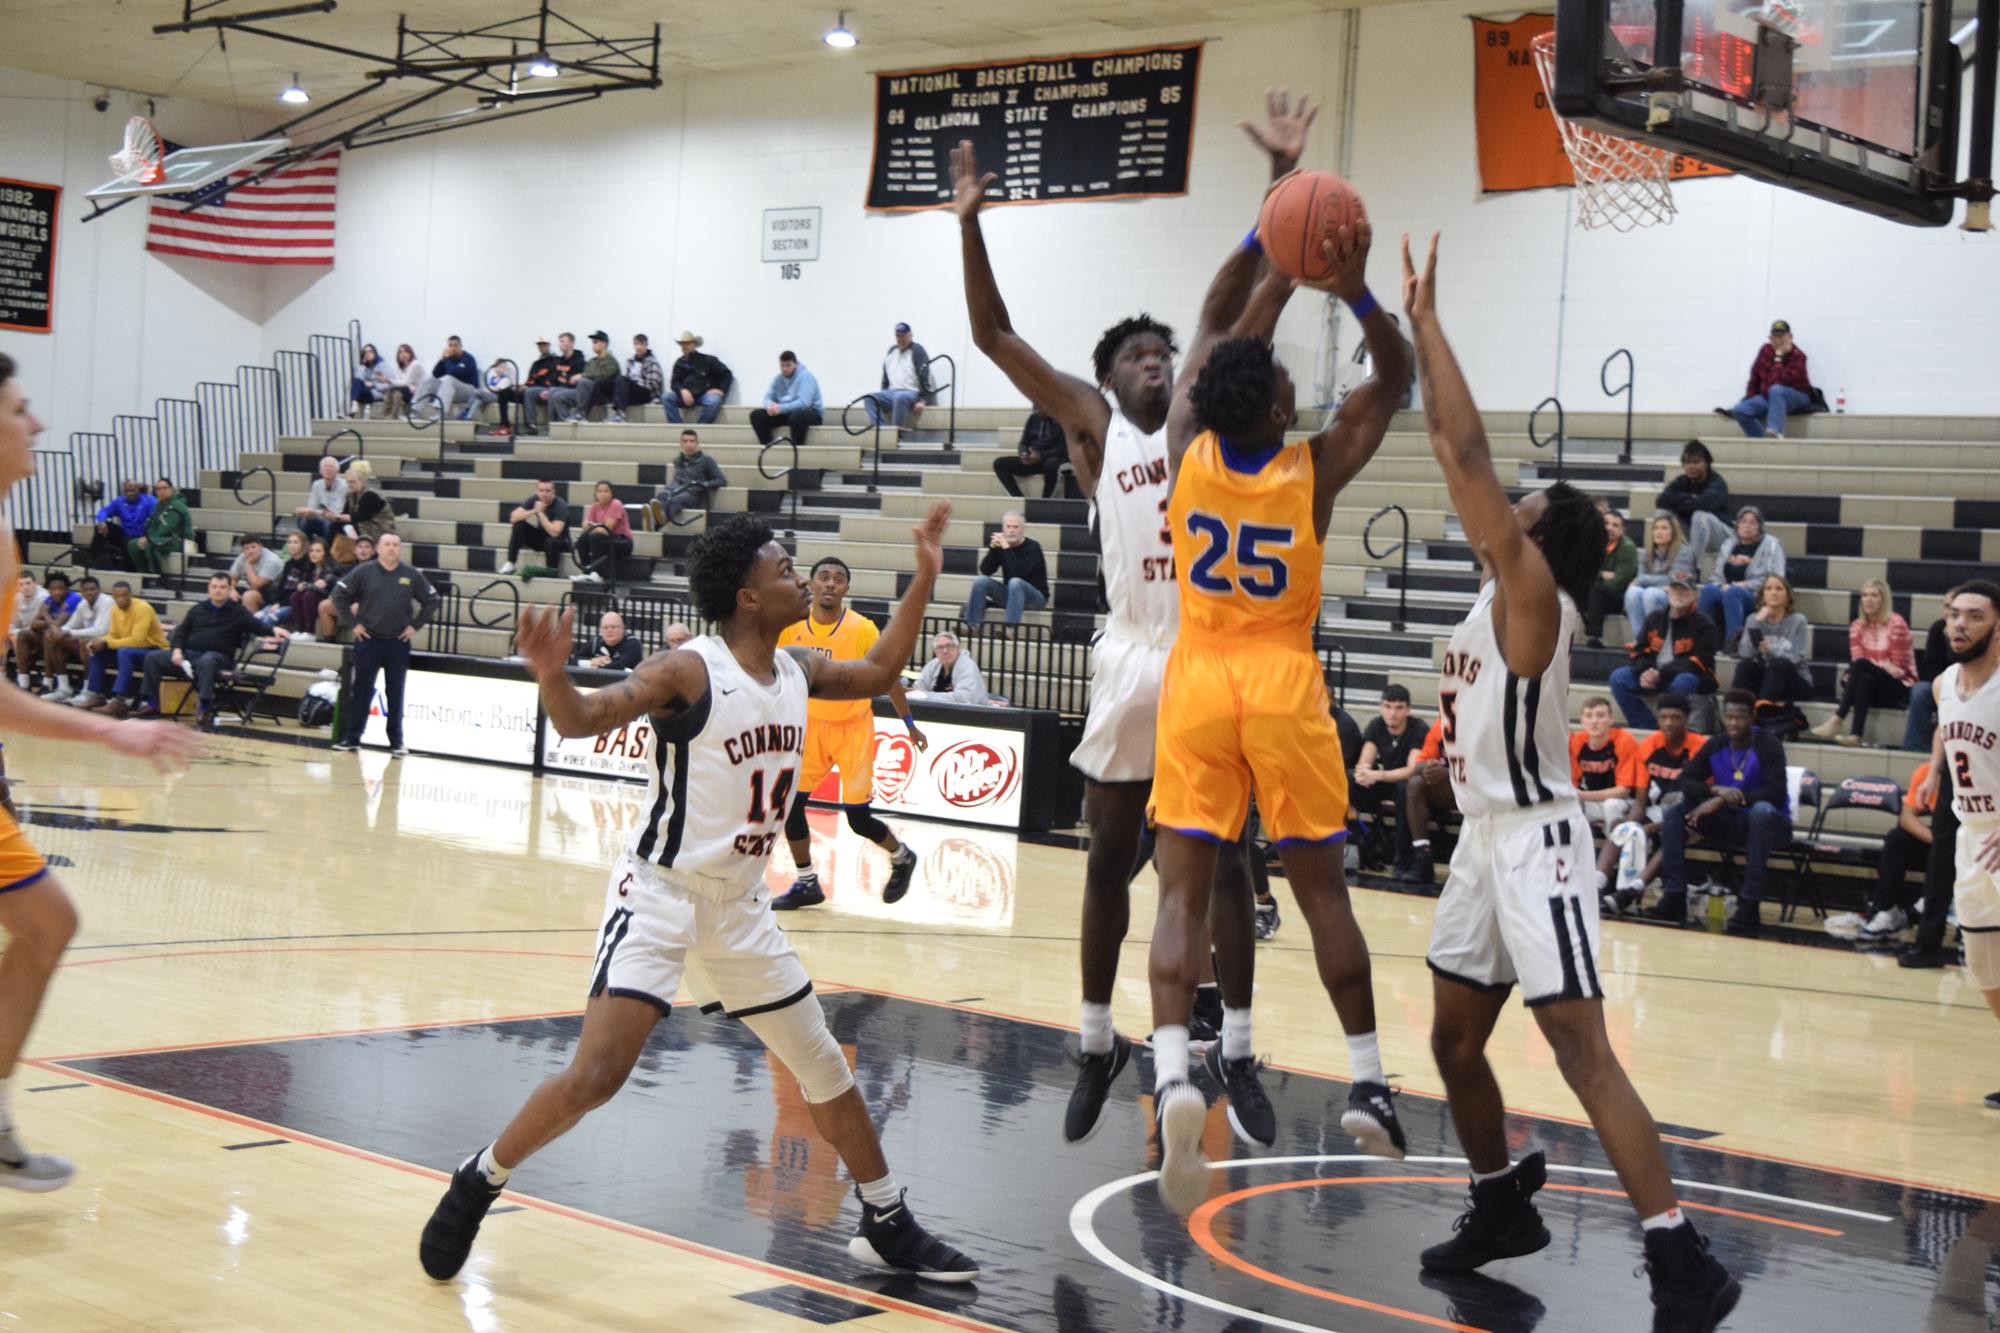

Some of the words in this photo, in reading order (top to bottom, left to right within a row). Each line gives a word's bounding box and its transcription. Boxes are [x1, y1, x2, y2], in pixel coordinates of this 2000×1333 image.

[890, 72, 961, 96] NATIONAL
[976, 62, 1076, 87] BASKETBALL
[1092, 53, 1183, 77] CHAMPIONS
[951, 91, 1000, 107] REGION
[1034, 82, 1109, 101] CHAMPIONS
[1160, 86, 1182, 104] 85
[914, 112, 980, 131] OKLAHOMA
[1004, 106, 1049, 124] STATE
[1072, 98, 1147, 119] CHAMPIONS
[0, 188, 34, 206] 1982
[780, 263, 801, 280] 105
[1186, 507, 1296, 601] 25
[402, 703, 482, 728] rmstrong
[593, 726, 650, 760] BAS
[1953, 750, 1974, 788] 2
[747, 767, 796, 825] 14
